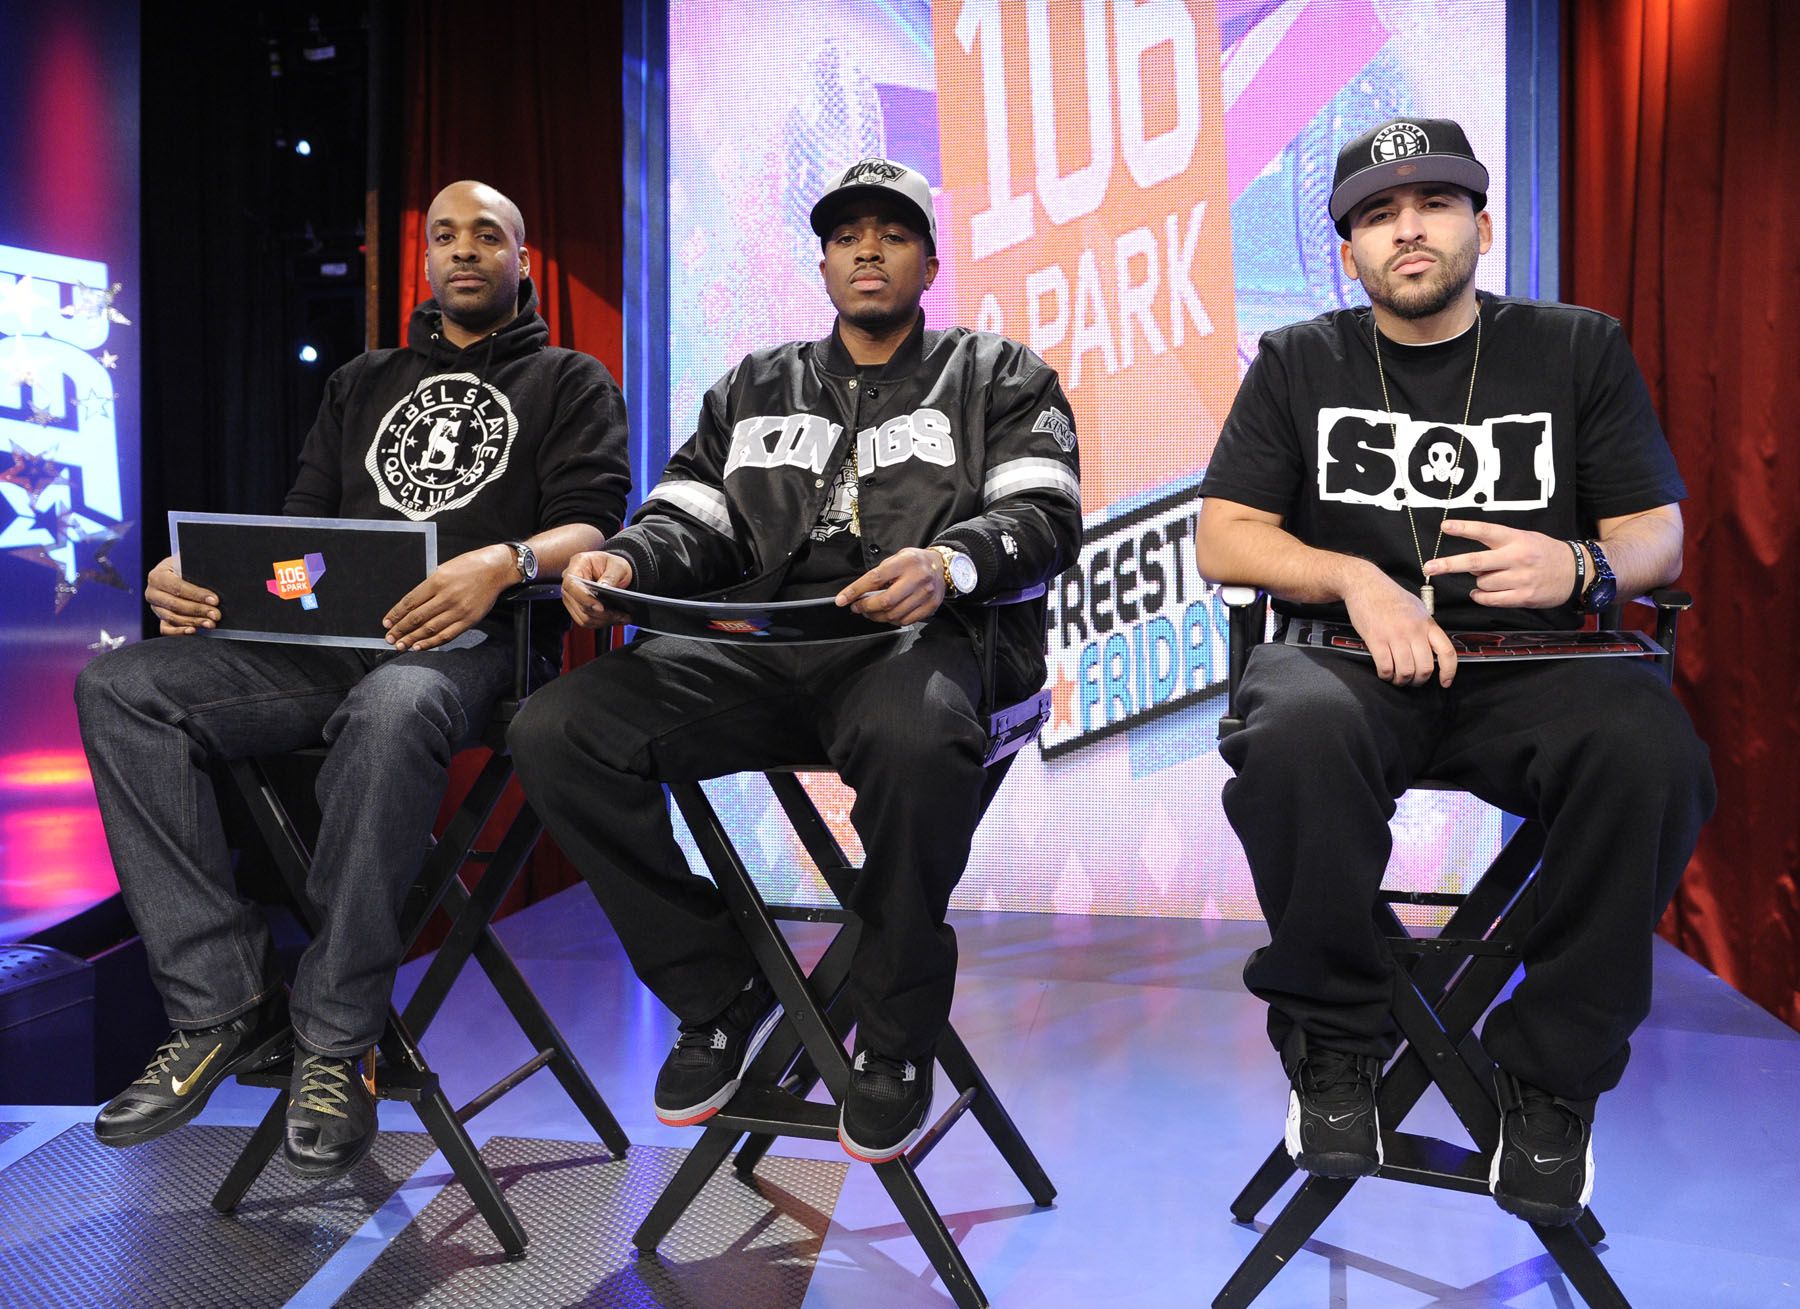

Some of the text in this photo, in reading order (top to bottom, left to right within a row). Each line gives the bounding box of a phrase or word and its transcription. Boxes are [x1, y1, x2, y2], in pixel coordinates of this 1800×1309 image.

[955, 0, 1200, 261] 106
[1374, 124, 1425, 146] BROOKLYN
[1393, 133, 1408, 159] B
[842, 163, 903, 183] KINGS
[1025, 200, 1216, 391] PARK
[278, 566, 306, 585] 106
[1047, 512, 1200, 650] REEST
